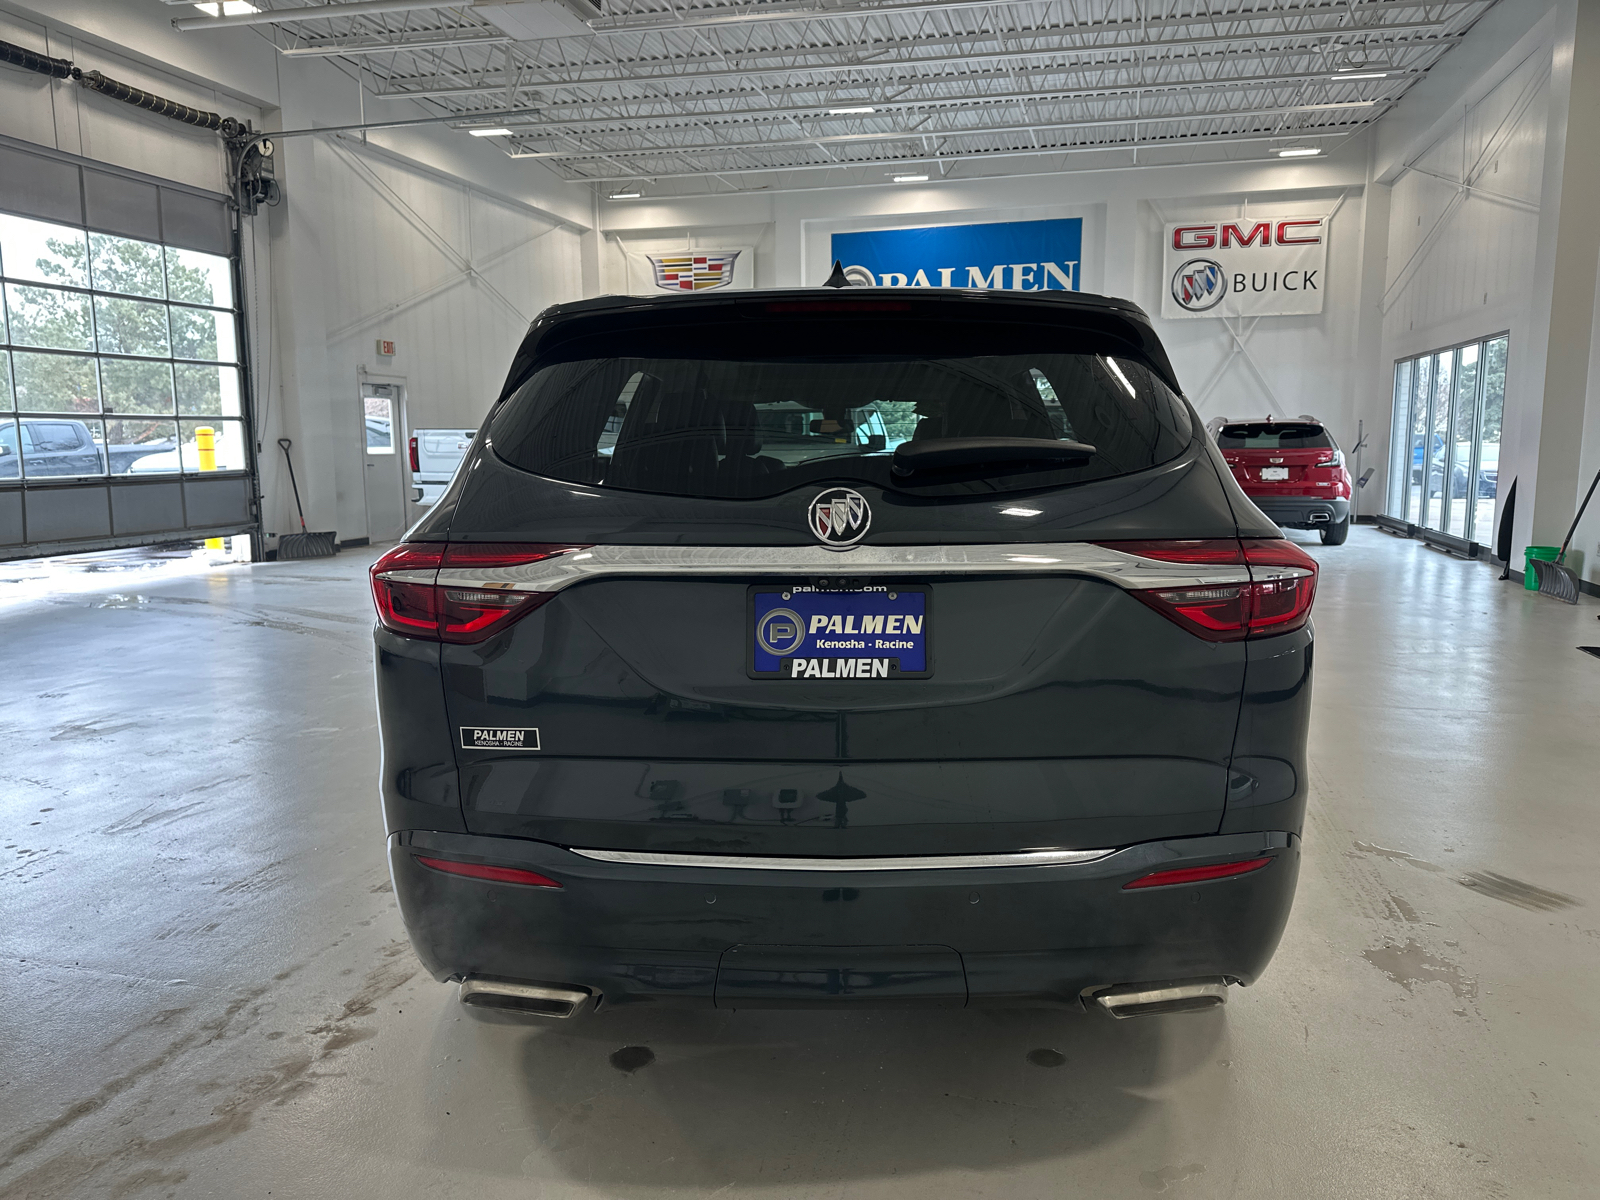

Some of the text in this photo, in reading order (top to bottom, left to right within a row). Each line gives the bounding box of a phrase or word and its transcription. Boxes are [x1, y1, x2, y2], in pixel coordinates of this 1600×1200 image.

[1172, 218, 1322, 251] GMC
[1233, 270, 1318, 293] BUICK
[770, 623, 796, 643] P
[808, 615, 923, 635] PALMEN
[816, 639, 865, 649] Kenosha
[875, 639, 914, 649] Racine
[791, 658, 889, 678] PALMEN
[473, 730, 524, 741] PALMEN
